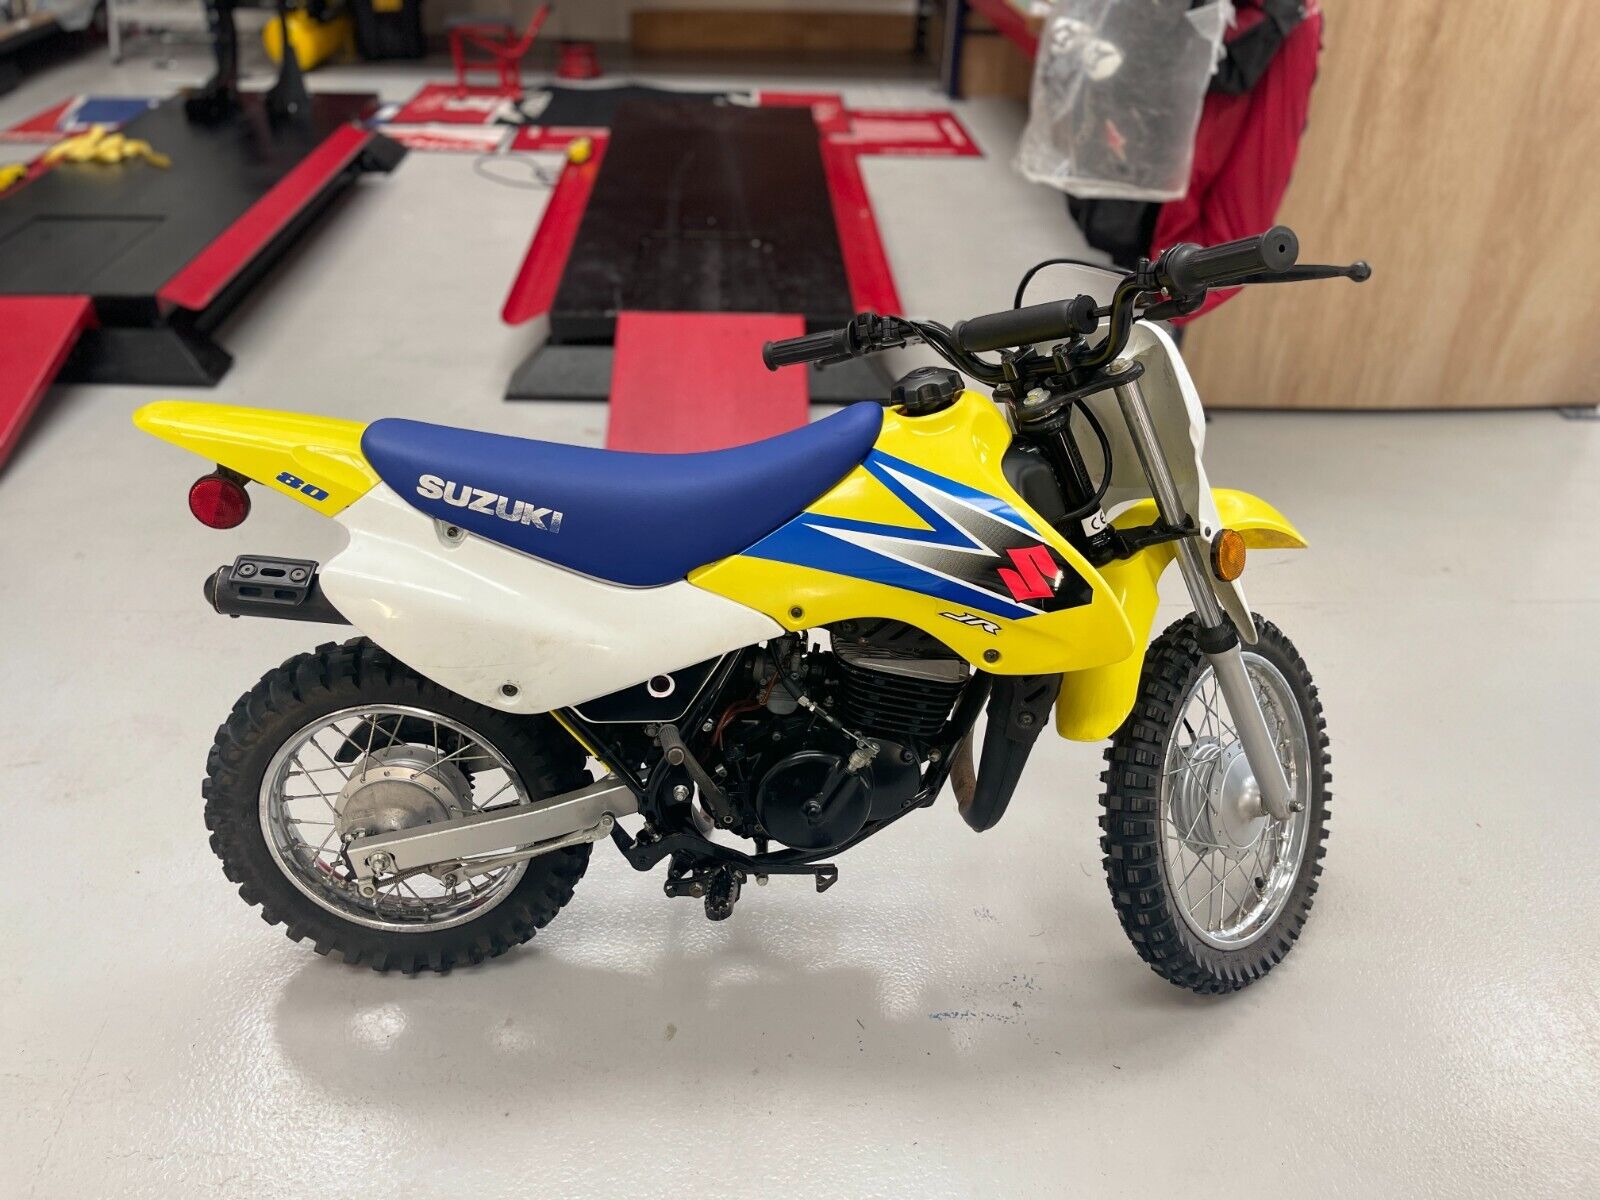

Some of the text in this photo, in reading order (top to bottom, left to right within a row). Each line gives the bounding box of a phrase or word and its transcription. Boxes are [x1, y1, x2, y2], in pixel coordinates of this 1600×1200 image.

[276, 472, 329, 501] 80
[416, 474, 563, 533] SUZUKI
[938, 612, 1002, 636] JR
